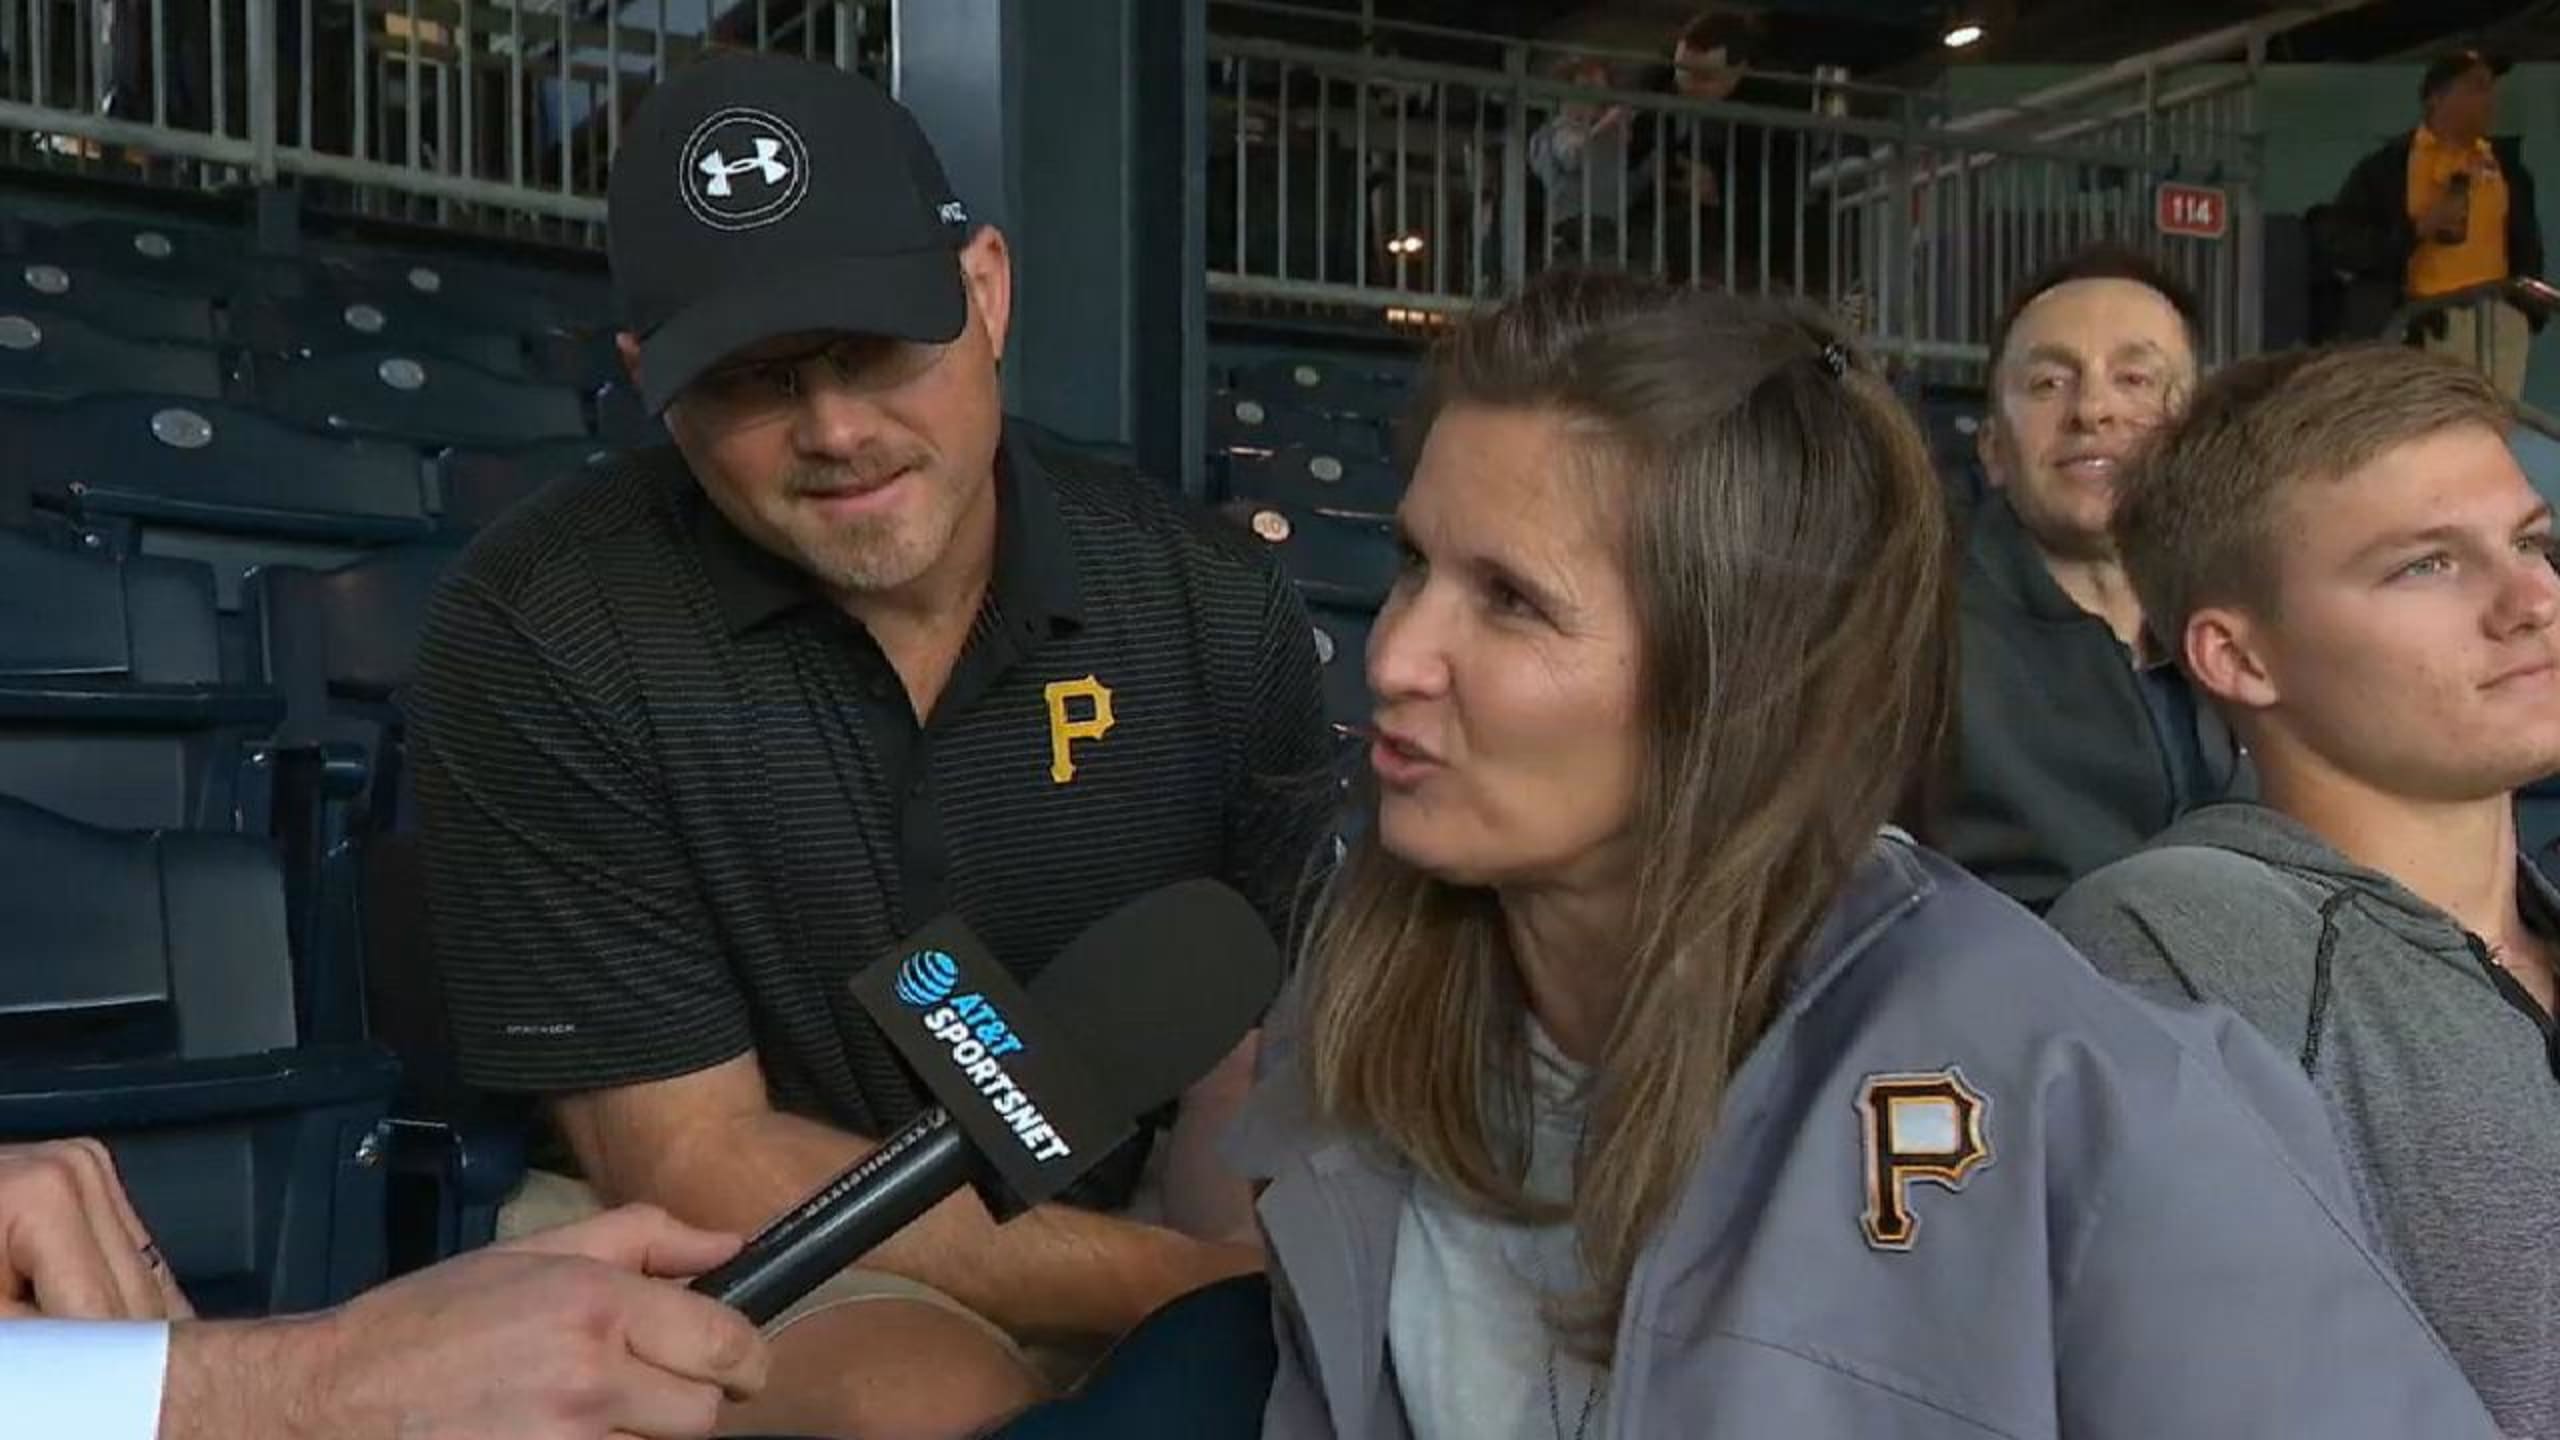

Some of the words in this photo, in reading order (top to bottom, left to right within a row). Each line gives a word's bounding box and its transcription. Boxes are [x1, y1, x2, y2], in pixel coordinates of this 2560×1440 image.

[2173, 196, 2211, 225] 114
[1044, 674, 1115, 784] P
[950, 992, 1024, 1056] AT&T
[924, 1006, 1071, 1162] SPORTSNET
[1856, 1065, 1997, 1250] P
